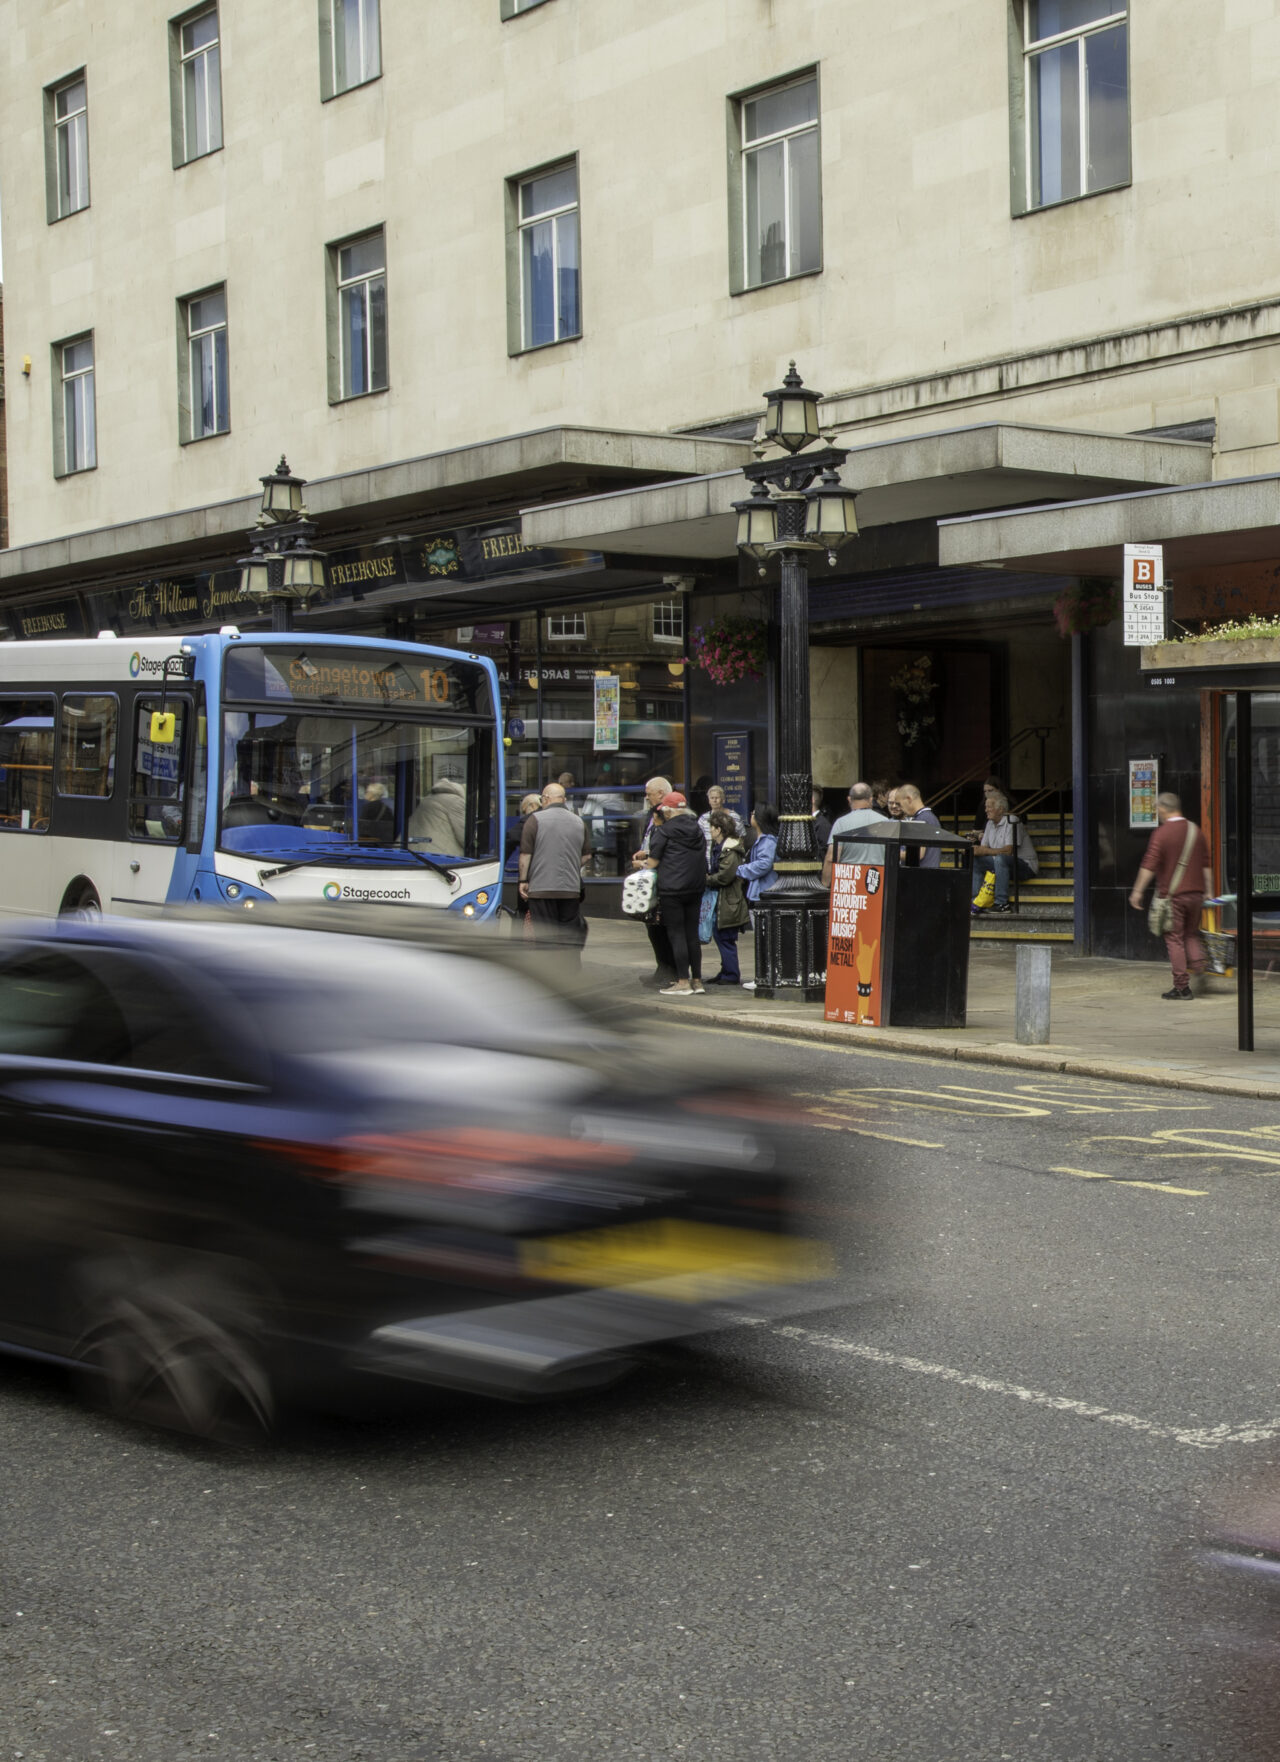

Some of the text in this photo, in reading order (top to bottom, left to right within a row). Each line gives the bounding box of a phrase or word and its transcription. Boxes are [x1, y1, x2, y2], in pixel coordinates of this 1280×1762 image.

[331, 556, 396, 585] FREEHOUSE
[1137, 562, 1151, 580] B
[129, 587, 152, 619] The
[155, 581, 198, 616] William
[1129, 592, 1159, 601] Bus Stop
[22, 612, 67, 635] FREEHOUSE
[419, 669, 449, 703] 10
[835, 864, 861, 879] WHAT IS
[343, 886, 411, 900] Stagecoach
[833, 879, 857, 893] A BIN'S
[833, 893, 867, 910] FAVOURITE
[832, 908, 859, 923] TYPE OF
[831, 922, 857, 938] MUSIC?
[831, 937, 853, 952] TRASH
[830, 951, 854, 967] METAL!
